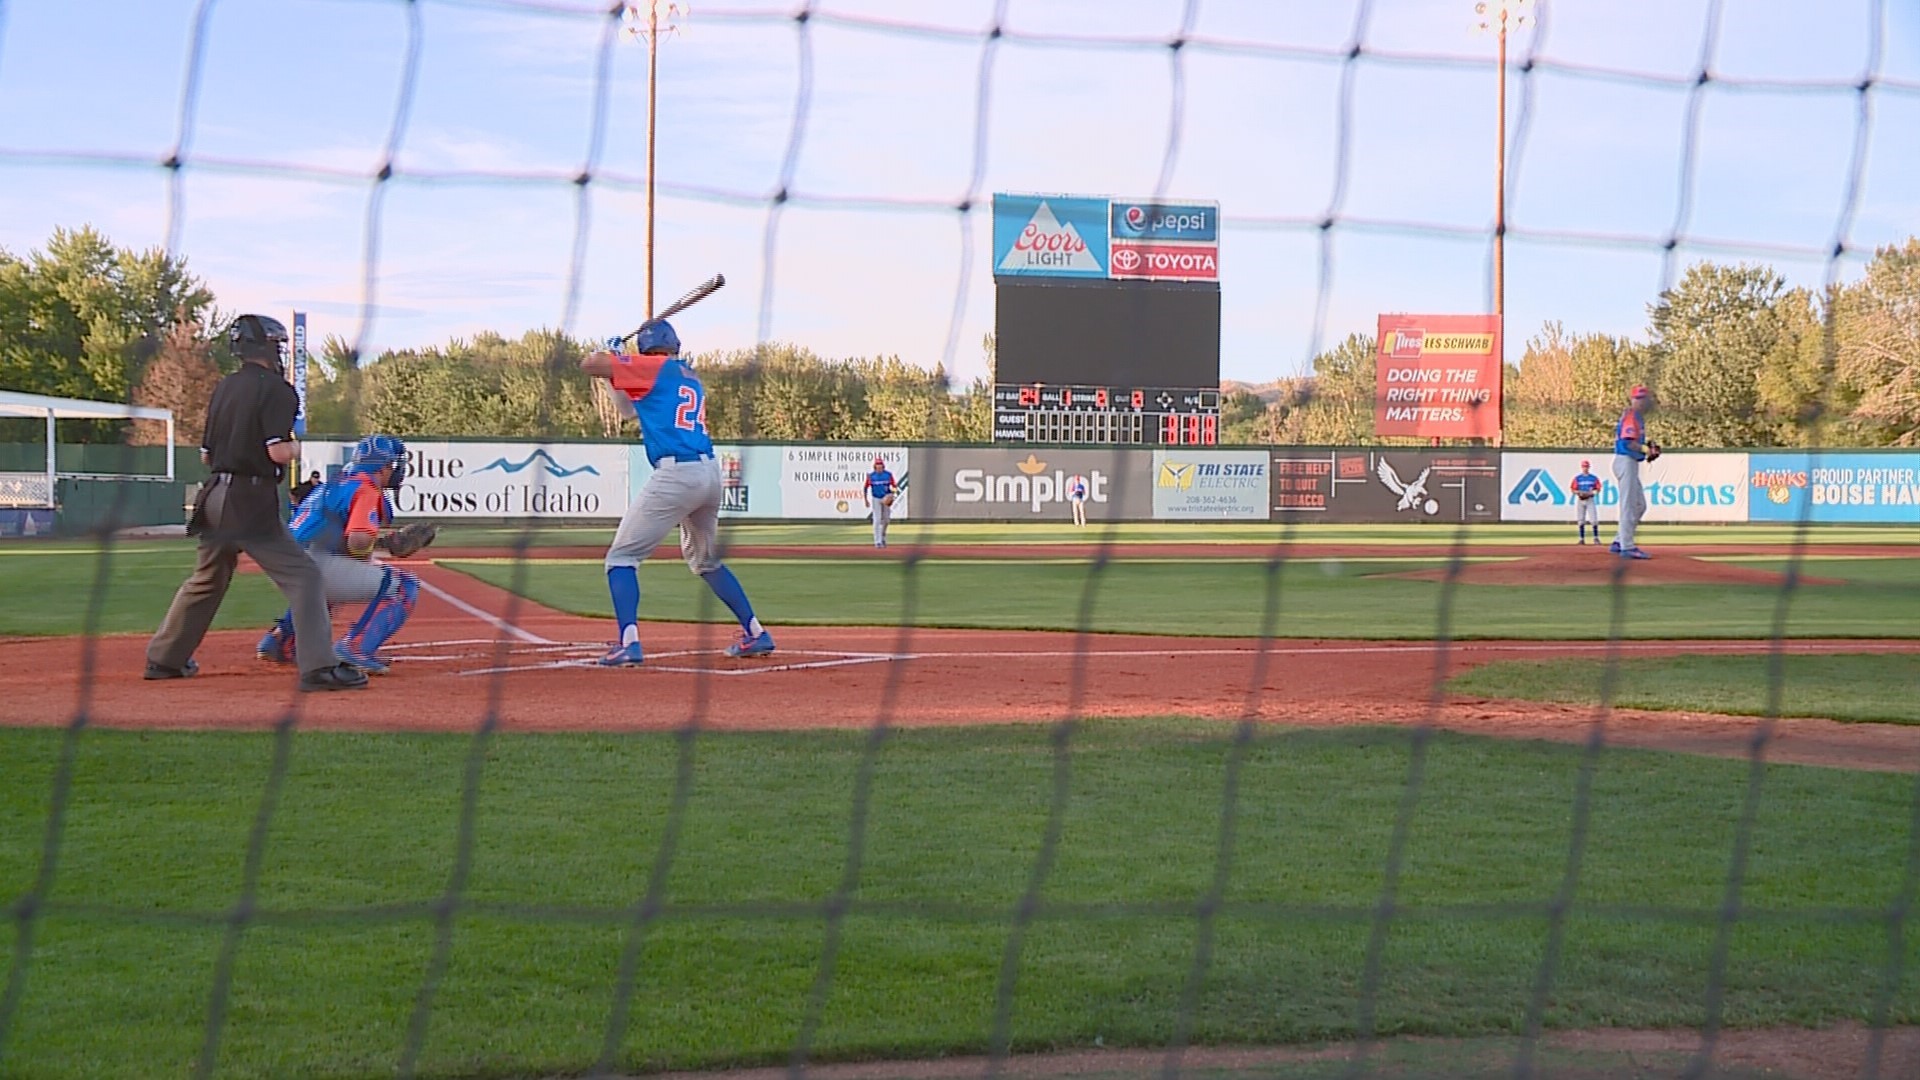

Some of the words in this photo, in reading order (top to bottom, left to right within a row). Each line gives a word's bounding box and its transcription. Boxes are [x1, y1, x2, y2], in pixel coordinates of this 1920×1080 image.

[1152, 212, 1206, 233] pepsi
[1015, 223, 1086, 252] Coors
[1027, 251, 1073, 266] LIGHT
[1145, 253, 1216, 271] TOYOTA
[295, 325, 305, 366] WORLD
[1396, 332, 1421, 350] Tires
[1443, 337, 1489, 349] SCHWAB
[1387, 368, 1441, 383] DOING
[1446, 369, 1477, 383] THE
[1020, 388, 1039, 405] 24
[1387, 388, 1438, 402] RIGHT
[1441, 389, 1490, 403] THING
[999, 415, 1025, 424] GUEST
[1386, 407, 1465, 421] MATTERS.
[995, 430, 1025, 439] HAWKS
[404, 450, 464, 478] Blue
[788, 451, 795, 461] 6
[799, 451, 833, 462] SIMPLE
[837, 452, 901, 462] INGREDIENTS
[1198, 464, 1220, 476] TRI
[1224, 464, 1264, 476] STATE
[1280, 463, 1304, 474] FREE
[1306, 463, 1330, 475] HELP
[1812, 469, 1854, 484] PROUD
[1857, 470, 1914, 484] PARTNER
[794, 472, 840, 482] NOTHING
[844, 472, 865, 482] ARTI
[1199, 478, 1260, 488] ELECTRIC
[1280, 479, 1292, 490] TO
[1295, 479, 1317, 490] QUIT
[1751, 470, 1808, 488] HAWKS
[721, 487, 747, 506] NE
[818, 489, 831, 499] GO
[834, 490, 864, 499] HAWKS
[955, 469, 1107, 512] Simplot
[1812, 485, 1875, 505] BOISE
[394, 484, 478, 513] Cross
[485, 485, 515, 513] of
[523, 485, 600, 513] Idaho
[1280, 494, 1324, 506] TOBACCO
